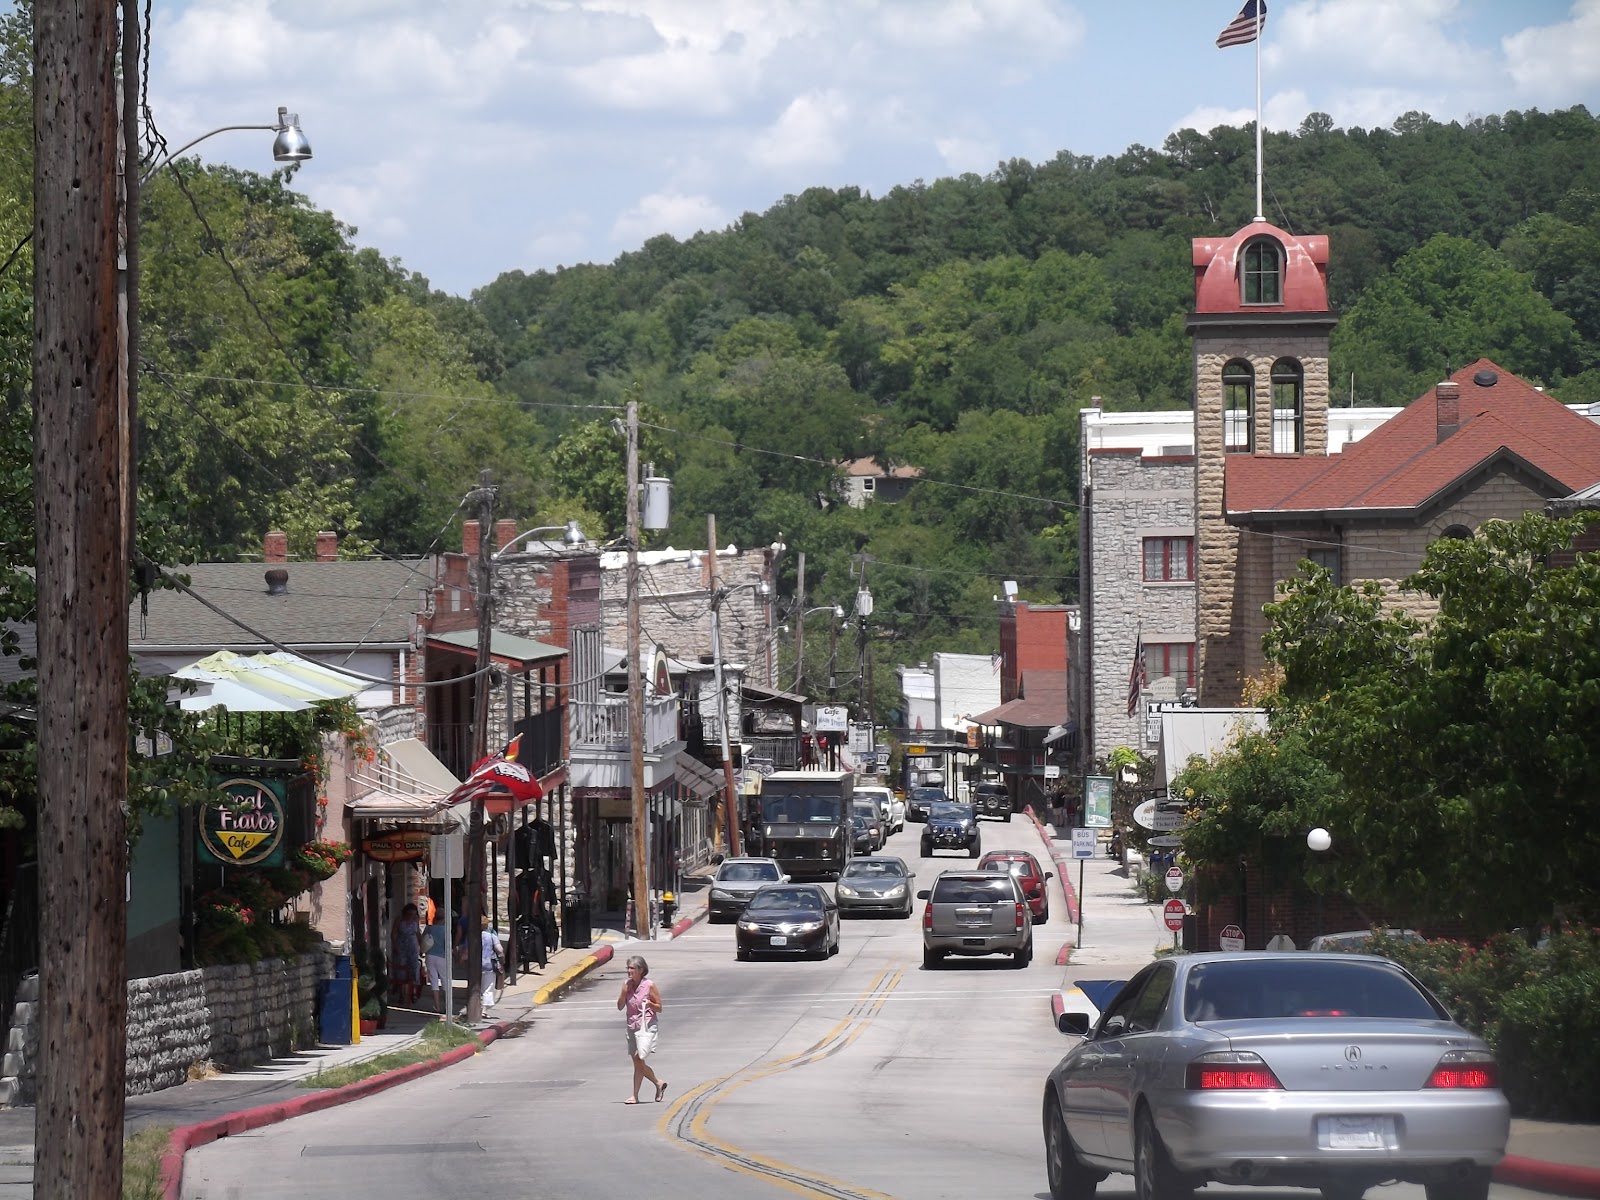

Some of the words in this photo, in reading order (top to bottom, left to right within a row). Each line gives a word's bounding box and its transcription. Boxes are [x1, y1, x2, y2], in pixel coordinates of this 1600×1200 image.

[824, 708, 840, 716] Cafe
[227, 834, 255, 852] Cafe
[1225, 929, 1240, 938] STOP
